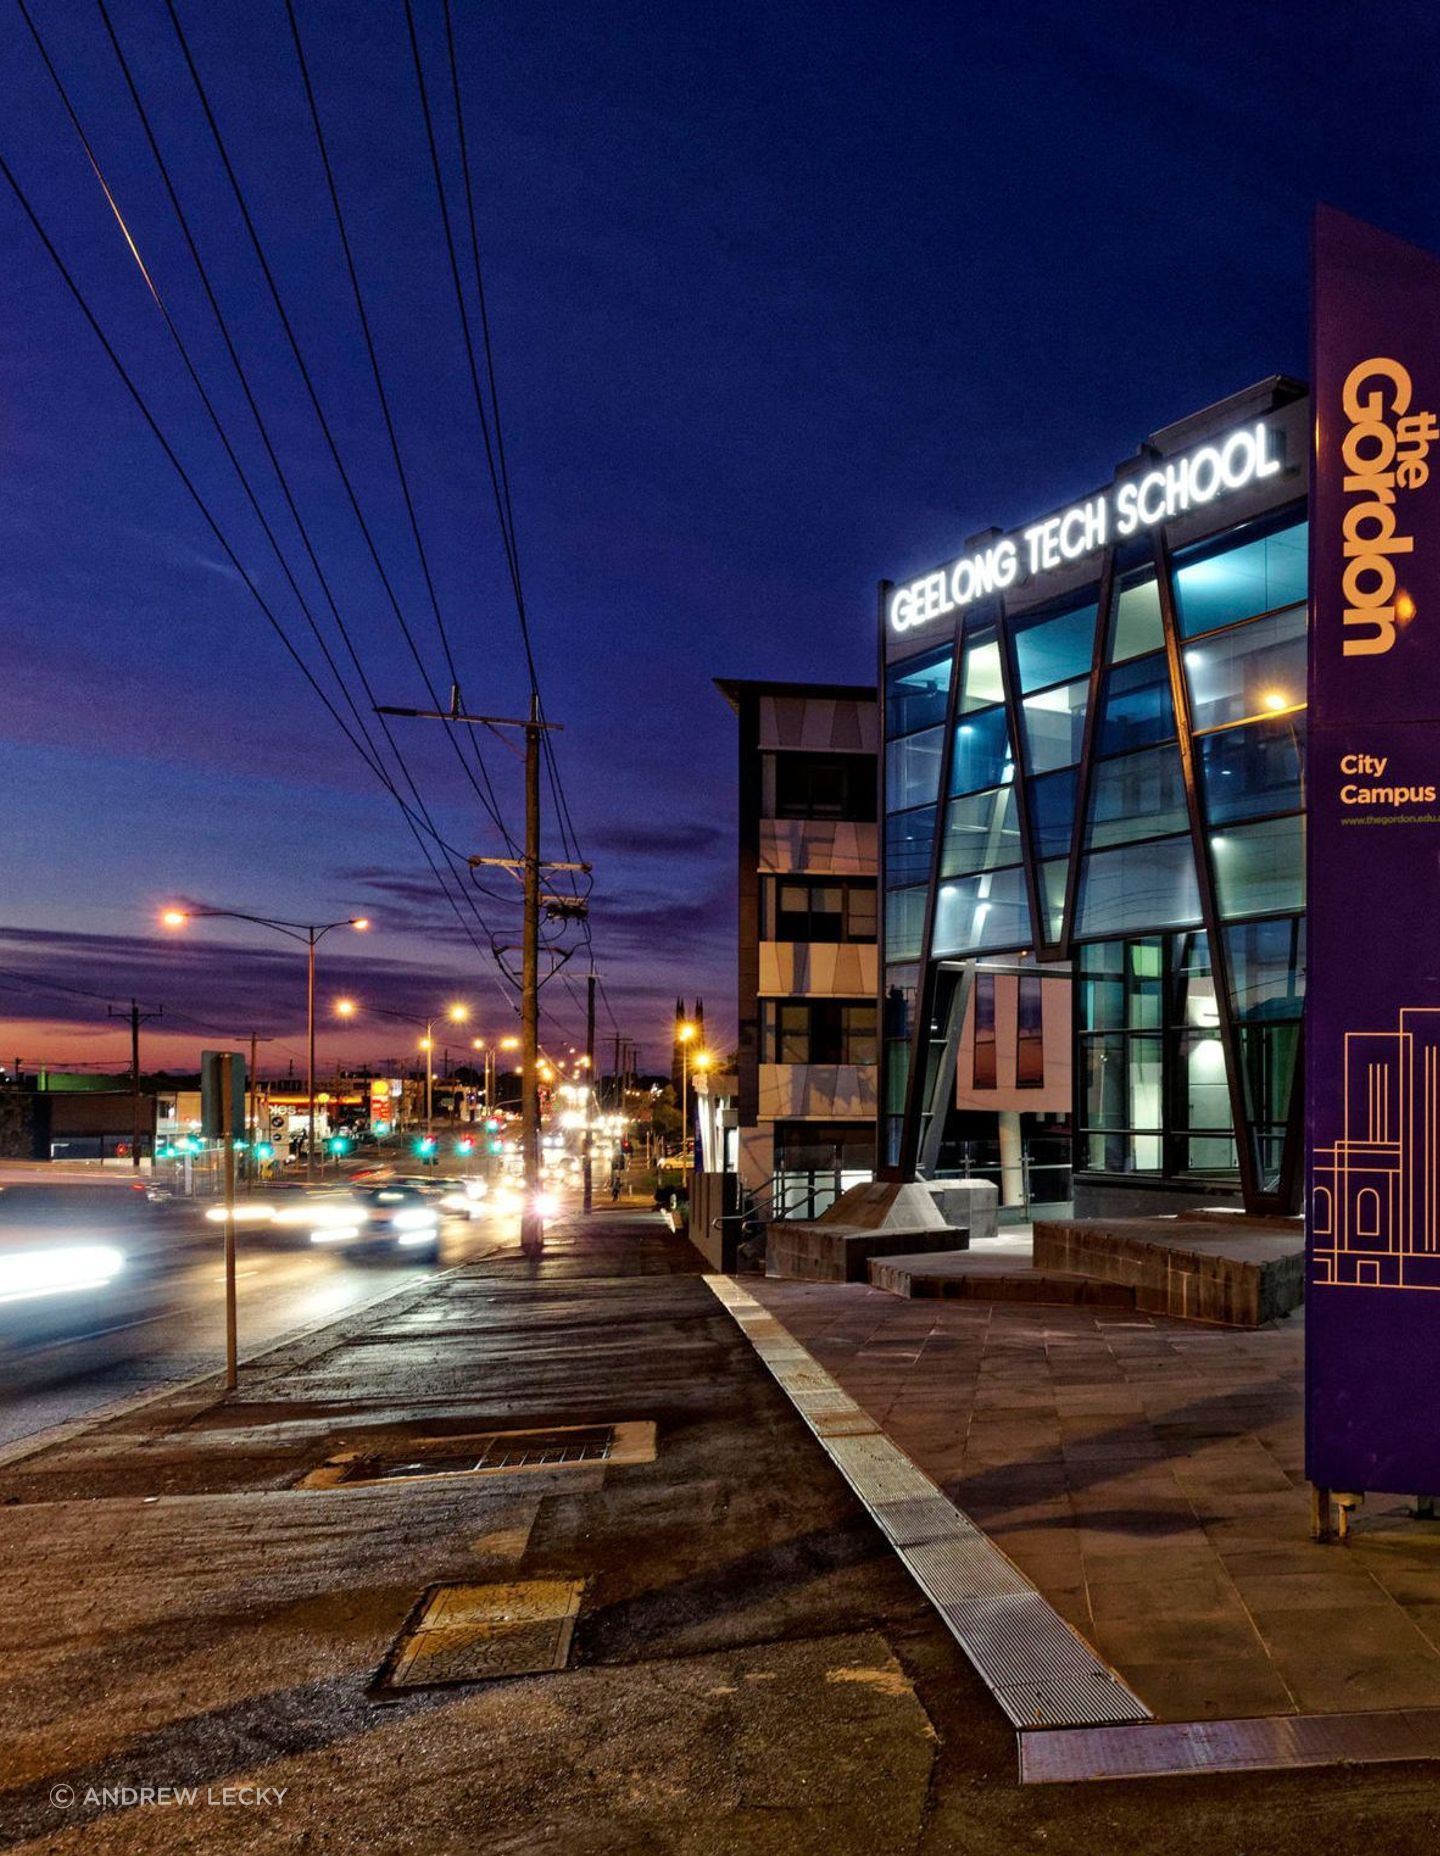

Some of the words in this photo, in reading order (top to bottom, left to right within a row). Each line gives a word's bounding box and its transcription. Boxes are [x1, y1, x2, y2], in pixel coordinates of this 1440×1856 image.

[1397, 411, 1440, 490] the
[890, 541, 1018, 633] GEELONG
[1025, 496, 1107, 575] TECH
[1116, 422, 1281, 536] SCHOOL
[1342, 357, 1413, 657] Gordon
[1340, 754, 1388, 777] City
[1340, 784, 1437, 807] Campus
